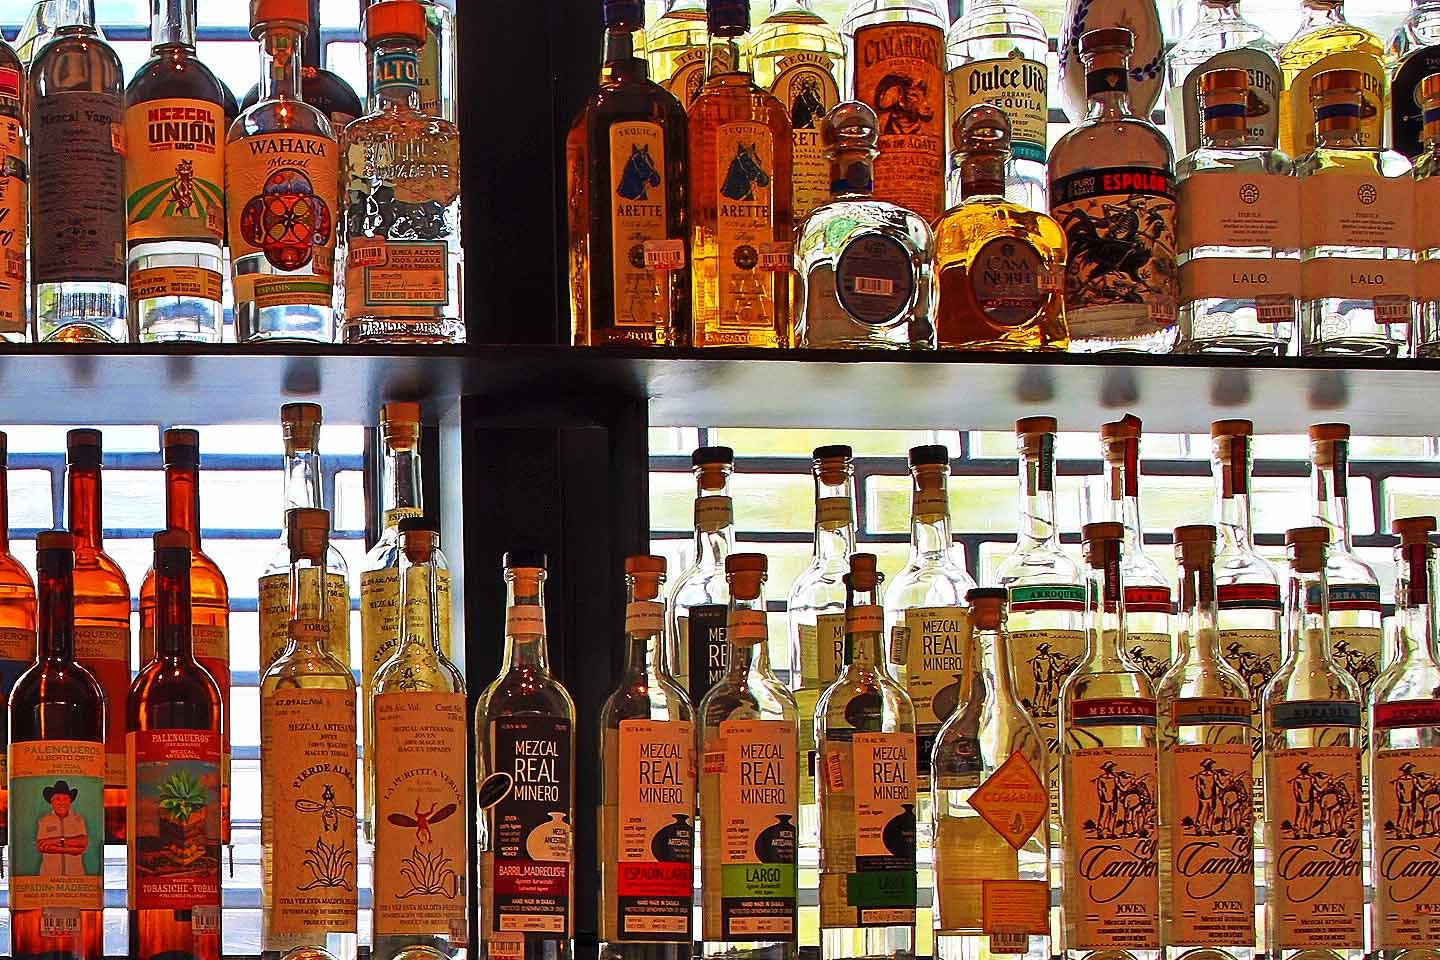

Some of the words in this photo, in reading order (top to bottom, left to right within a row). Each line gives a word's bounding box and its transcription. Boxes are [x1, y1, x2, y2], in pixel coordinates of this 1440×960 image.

[780, 55, 832, 70] TEQUILA
[377, 62, 415, 80] ALTO
[1021, 64, 1047, 90] Vid
[249, 138, 326, 156] WAHAKA
[269, 157, 310, 169] Mezcal
[617, 205, 662, 216] ARETTE
[721, 205, 769, 217] ARETTE
[922, 621, 959, 634] MEZCAL
[922, 636, 961, 655] REAL
[924, 657, 962, 670] MINERO
[152, 735, 209, 743] PALENQUEROS
[515, 741, 558, 757] MEZCAL
[640, 744, 682, 759] MEZCAL
[741, 744, 784, 759] MEZCAL
[873, 747, 907, 760] MEZCAL
[293, 765, 329, 789] PIERDE
[515, 760, 559, 784] REAL
[640, 763, 683, 785] REAL
[741, 762, 784, 785] REAL
[873, 763, 908, 784] REAL
[515, 786, 558, 801] MINERO
[640, 788, 683, 803] MINERO
[741, 789, 785, 804] MINERO
[874, 787, 908, 800] MINERO
[746, 868, 780, 882] LARGO
[1116, 903, 1146, 914] JOVEN
[1212, 901, 1243, 910] JOVEN
[1312, 903, 1344, 913] JOVEN
